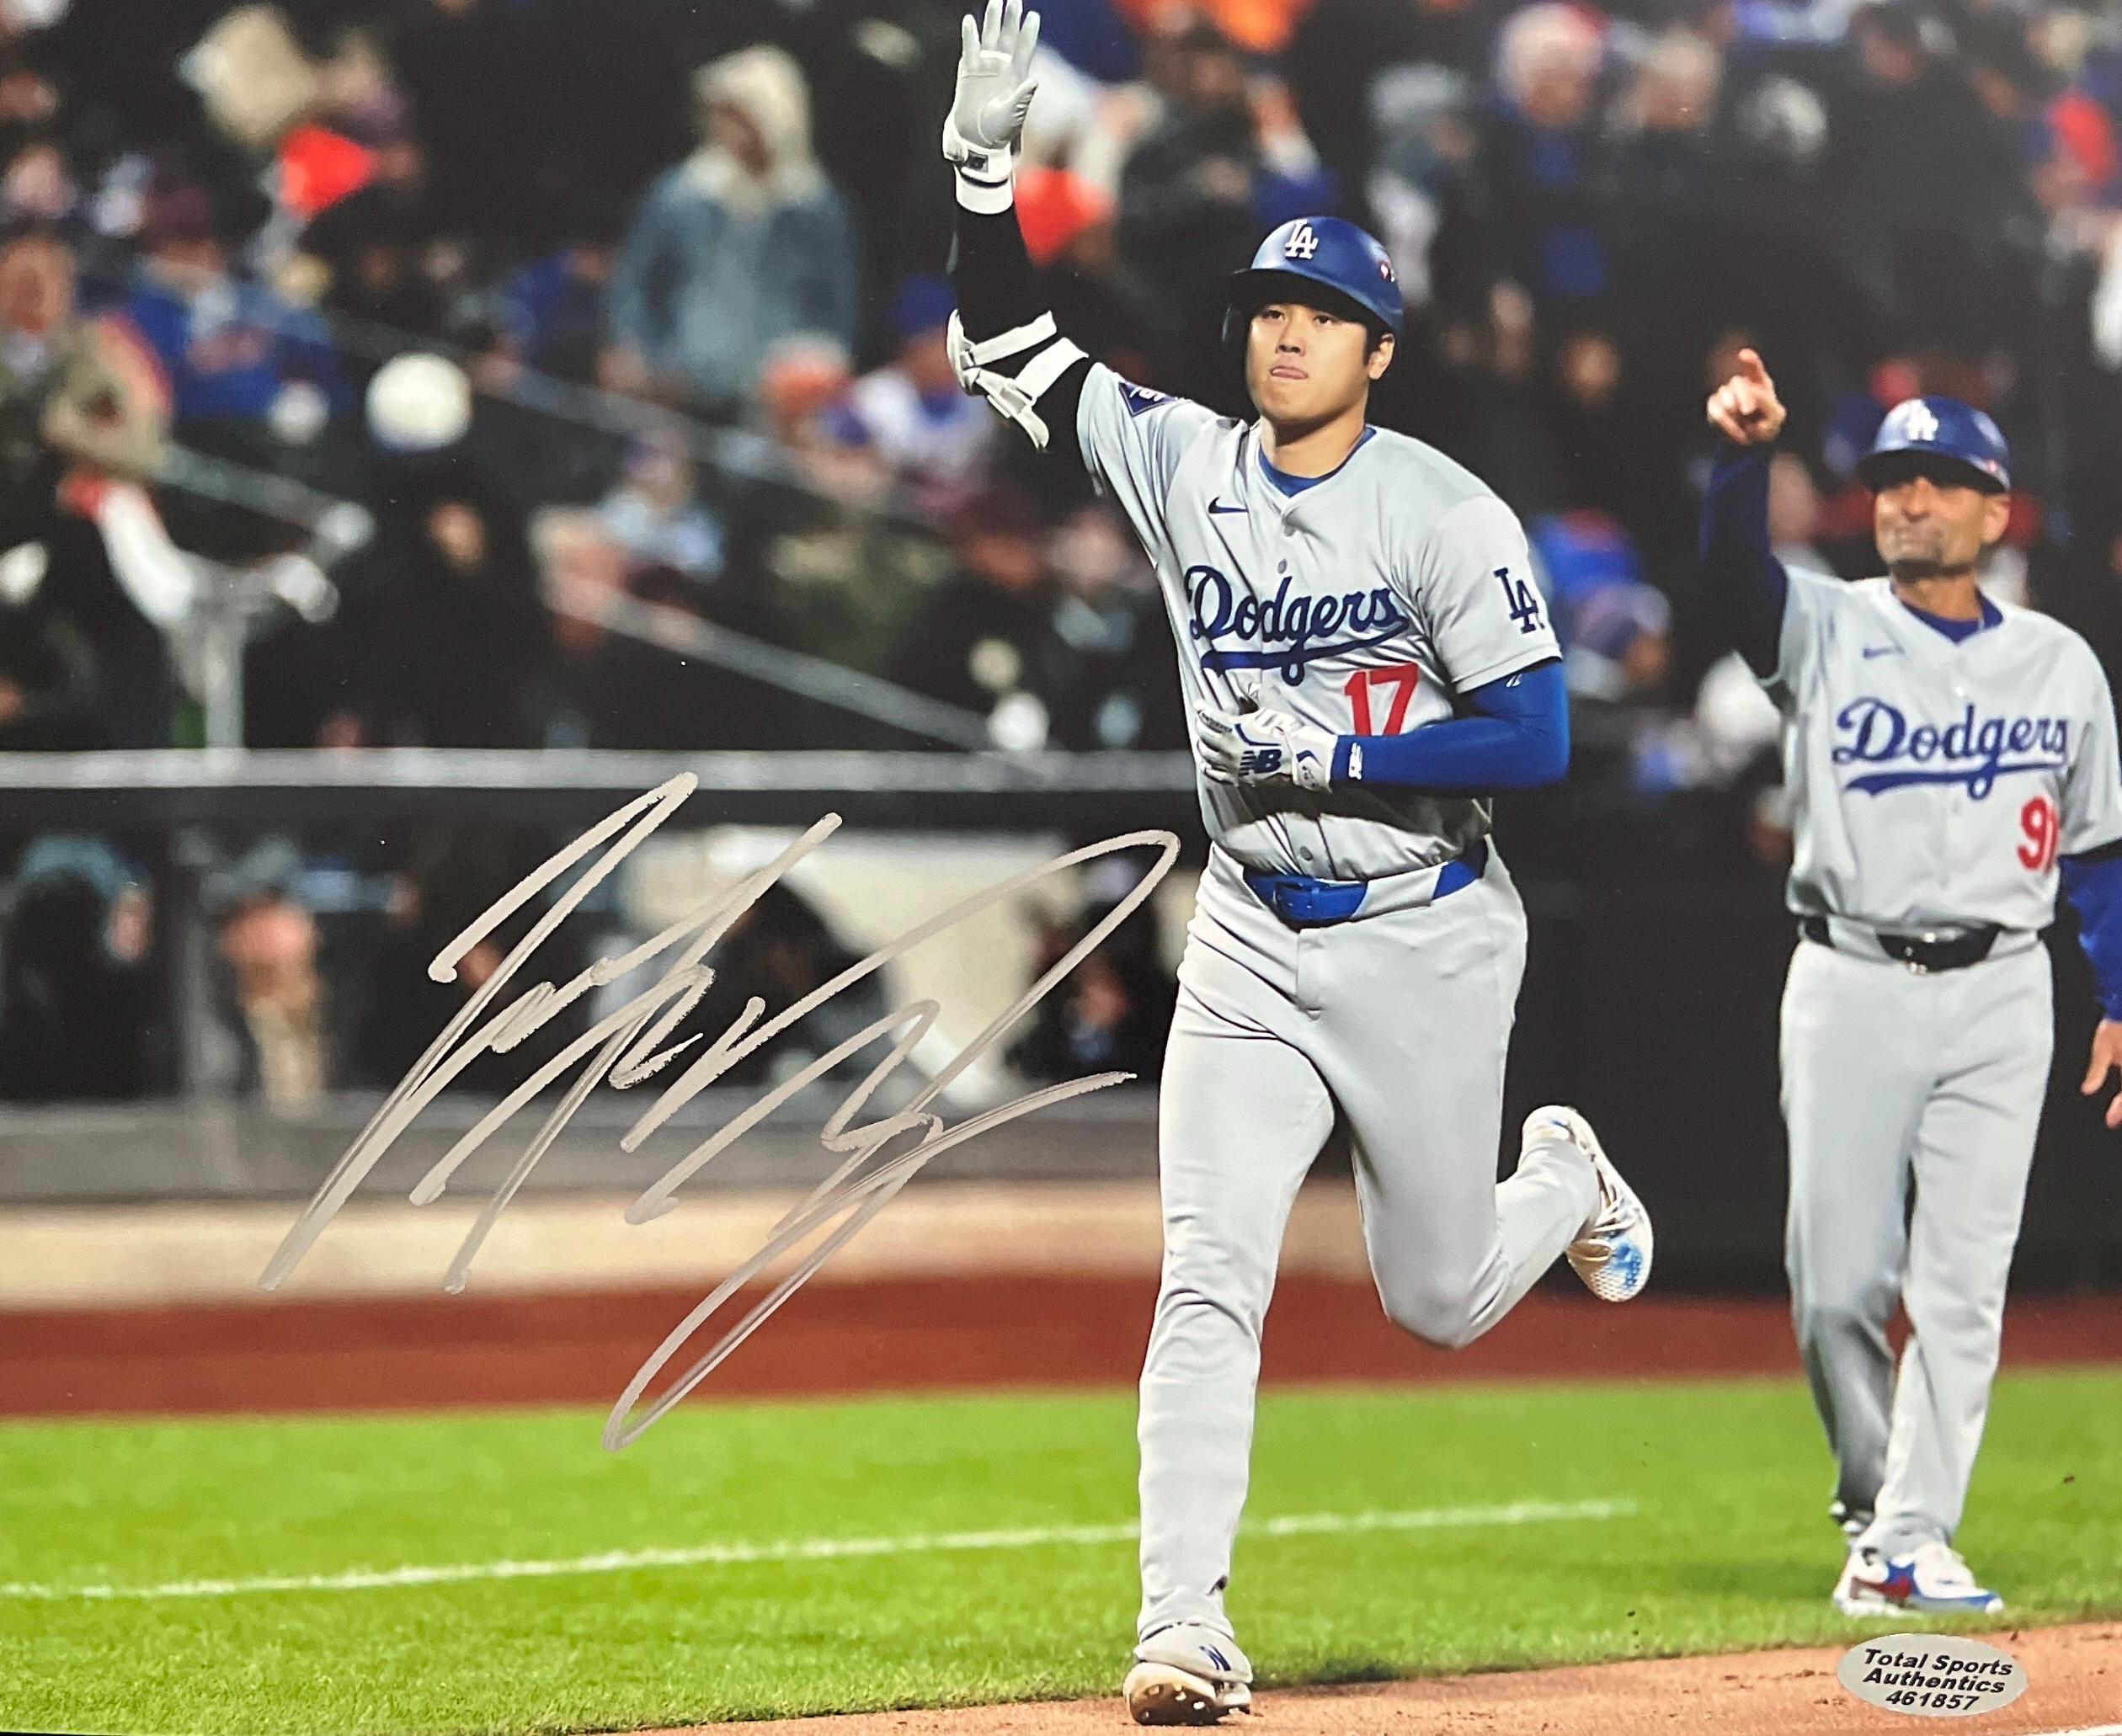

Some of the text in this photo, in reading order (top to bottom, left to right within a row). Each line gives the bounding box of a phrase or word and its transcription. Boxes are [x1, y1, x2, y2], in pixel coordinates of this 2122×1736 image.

[1284, 218, 1320, 259] LA
[1183, 565, 1410, 686] Dodgers
[1493, 567, 1545, 635] LA
[1345, 662, 1419, 736] 17
[1832, 698, 2067, 800] Dodgers
[1863, 1668, 2006, 1693] Authentics
[1864, 1648, 2013, 1675] Total Sports
[1885, 1690, 1980, 1711] 461857
